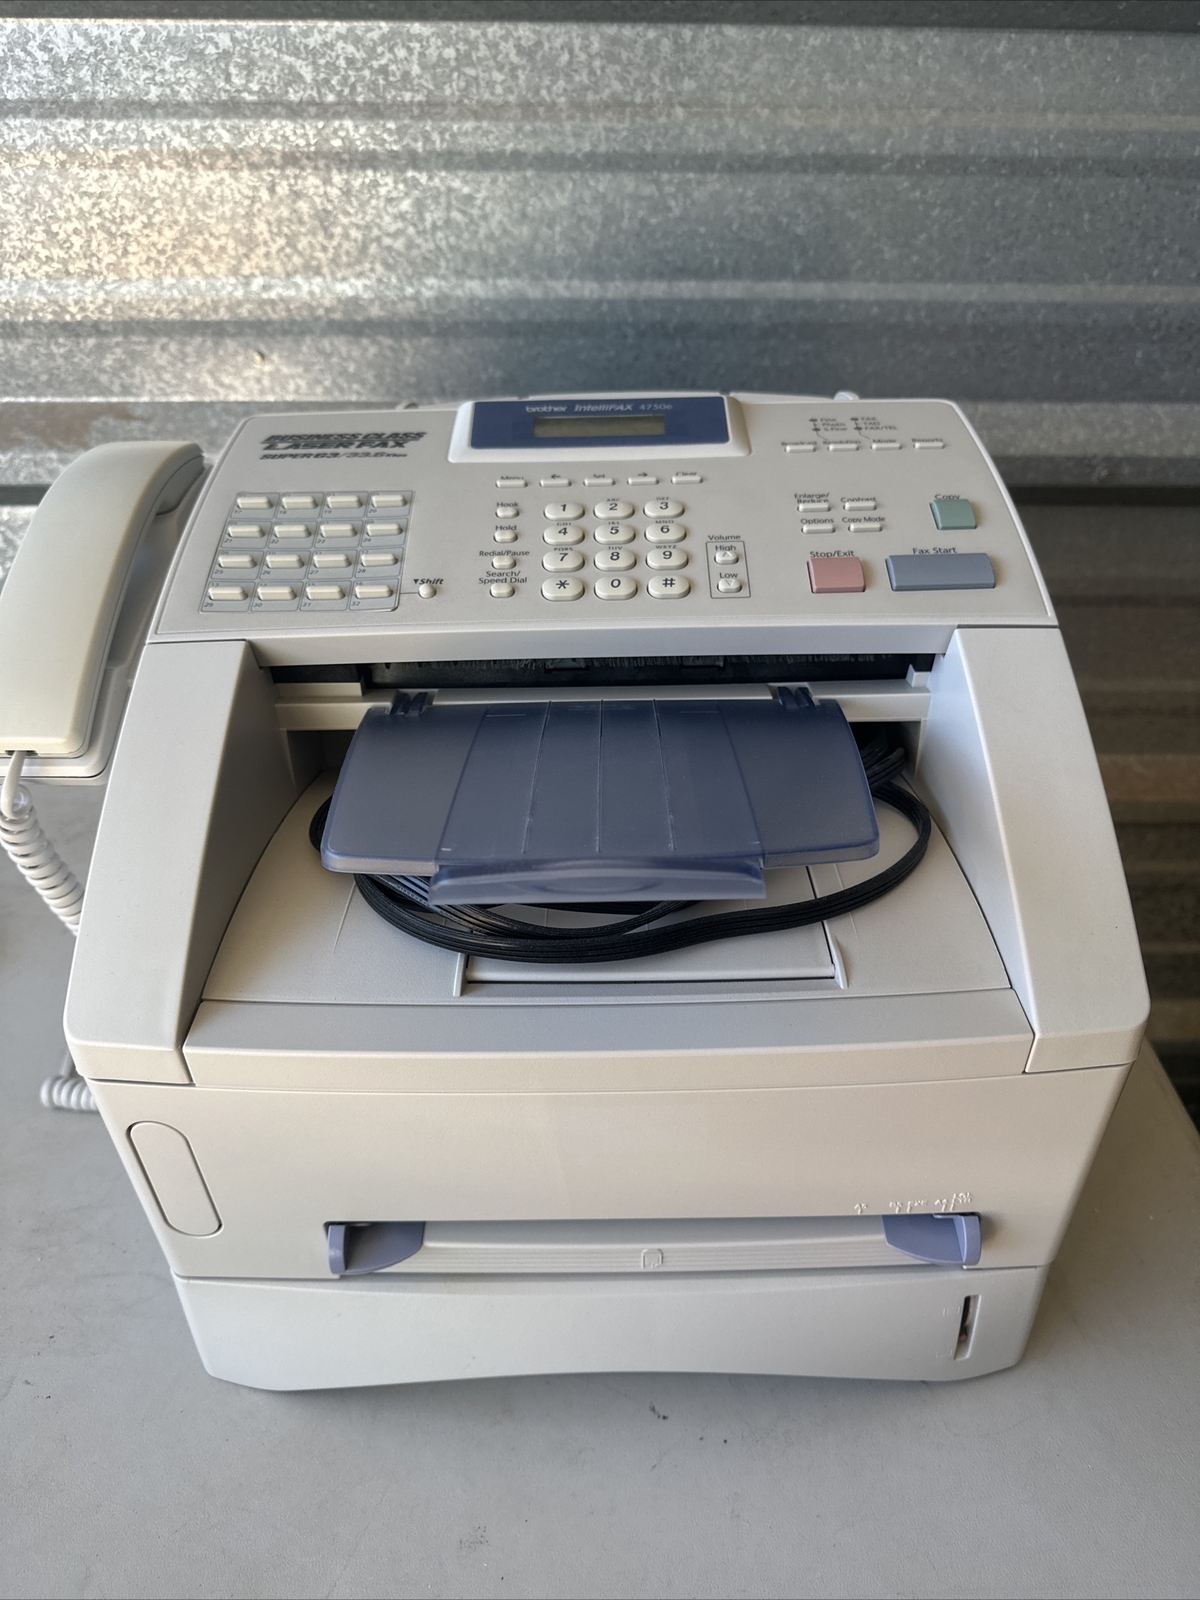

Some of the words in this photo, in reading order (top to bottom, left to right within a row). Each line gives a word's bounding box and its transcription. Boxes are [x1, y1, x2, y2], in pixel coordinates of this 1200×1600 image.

[525, 405, 568, 413] brother
[573, 403, 634, 412] IntelliFAX
[638, 403, 673, 411] 4750e
[262, 433, 362, 443] BUSINESS
[361, 431, 428, 441] CLASS
[262, 440, 355, 451] LASER
[355, 439, 410, 449] FAX
[259, 452, 313, 460] SUPER
[794, 492, 830, 500] Enlarge/
[934, 493, 961, 501] Copy
[560, 504, 567, 512] 1
[609, 503, 618, 511] 2
[659, 502, 669, 510] 3
[800, 517, 835, 525] Options
[841, 516, 862, 524] Copy
[558, 527, 568, 536] 4
[609, 526, 620, 535] 5
[660, 525, 670, 534] 6
[707, 534, 742, 542] Volume
[715, 544, 737, 552] High
[912, 547, 931, 555] Fax
[932, 546, 958, 555] Start
[478, 549, 530, 557] Redial/Pause
[559, 552, 569, 562] 7
[610, 551, 620, 561] 8
[662, 550, 673, 560] 9
[809, 550, 856, 559] Stop/Exit
[485, 570, 522, 578] Search/
[718, 571, 739, 579] Low
[420, 577, 445, 586] Shift
[478, 577, 508, 585] Speed
[610, 578, 621, 589] 0
[662, 577, 676, 588] #
